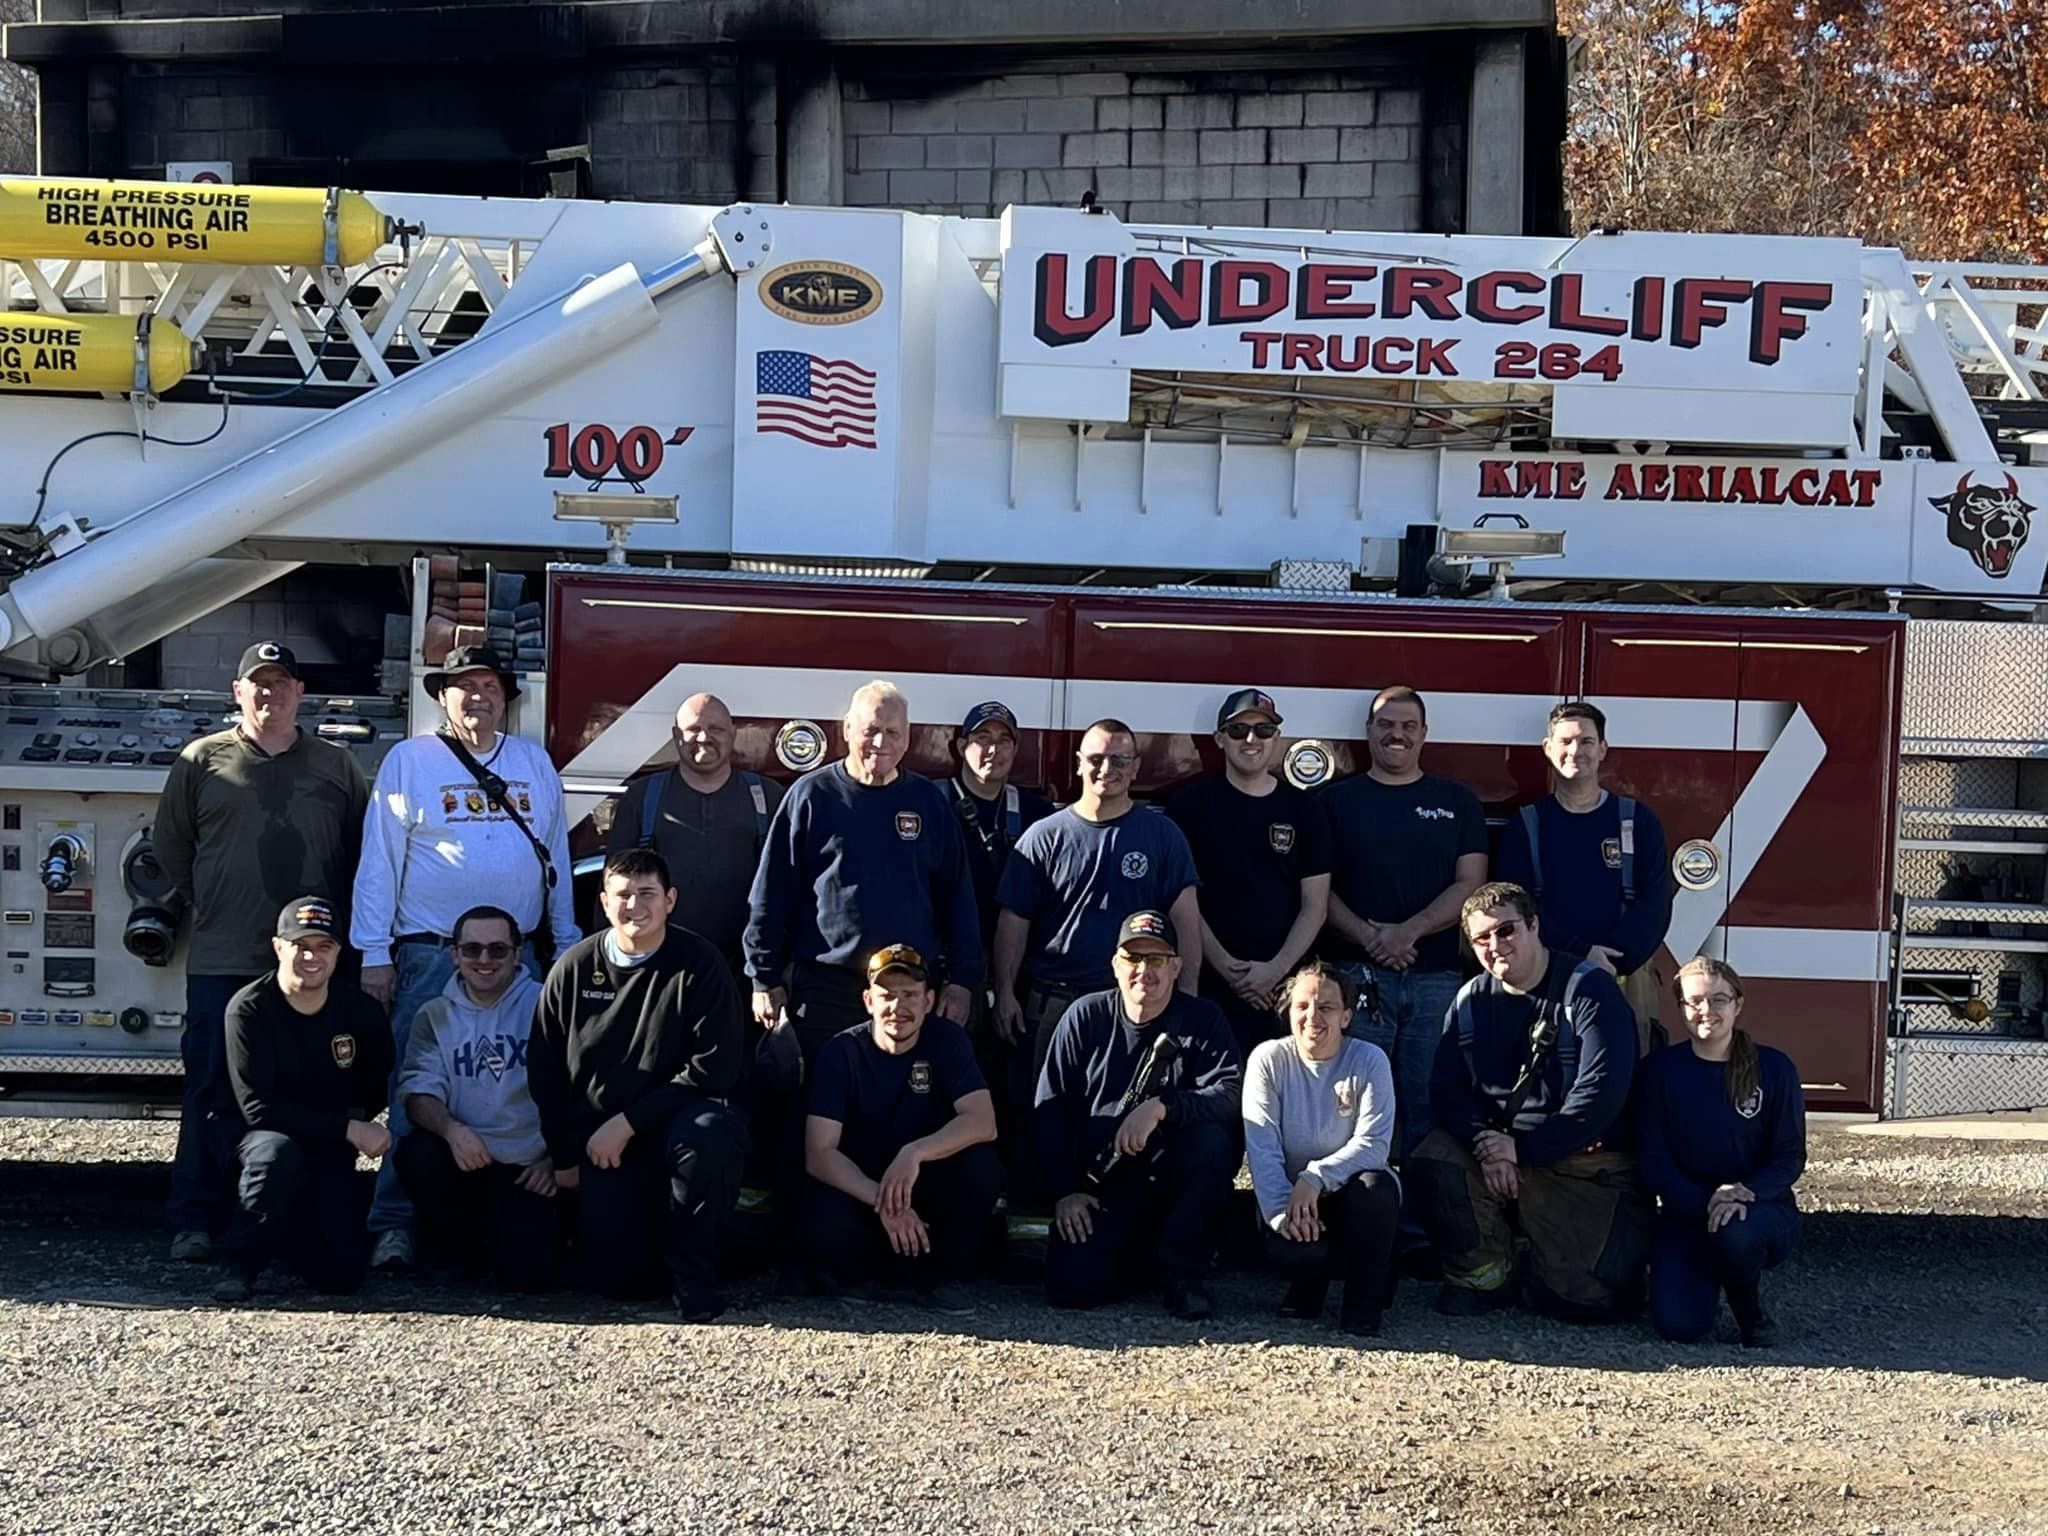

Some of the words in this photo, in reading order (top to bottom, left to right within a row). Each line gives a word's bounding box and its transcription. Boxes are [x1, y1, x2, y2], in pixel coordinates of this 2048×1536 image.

[38, 187, 99, 201] HIGH
[112, 190, 250, 208] PRESSURE
[46, 203, 193, 230] BREATHING
[205, 209, 249, 232] AIR
[85, 230, 155, 248] 4500
[167, 233, 208, 250] PSI
[782, 286, 859, 307] KME
[1033, 252, 1833, 366] UNDERCLIFF
[34, 348, 77, 370] AIR
[1239, 331, 1462, 376] TRUCK
[1494, 341, 1624, 382] 264
[1477, 460, 1587, 499] KME
[1604, 463, 1882, 507] AERIALCAT
[258, 643, 280, 660] C
